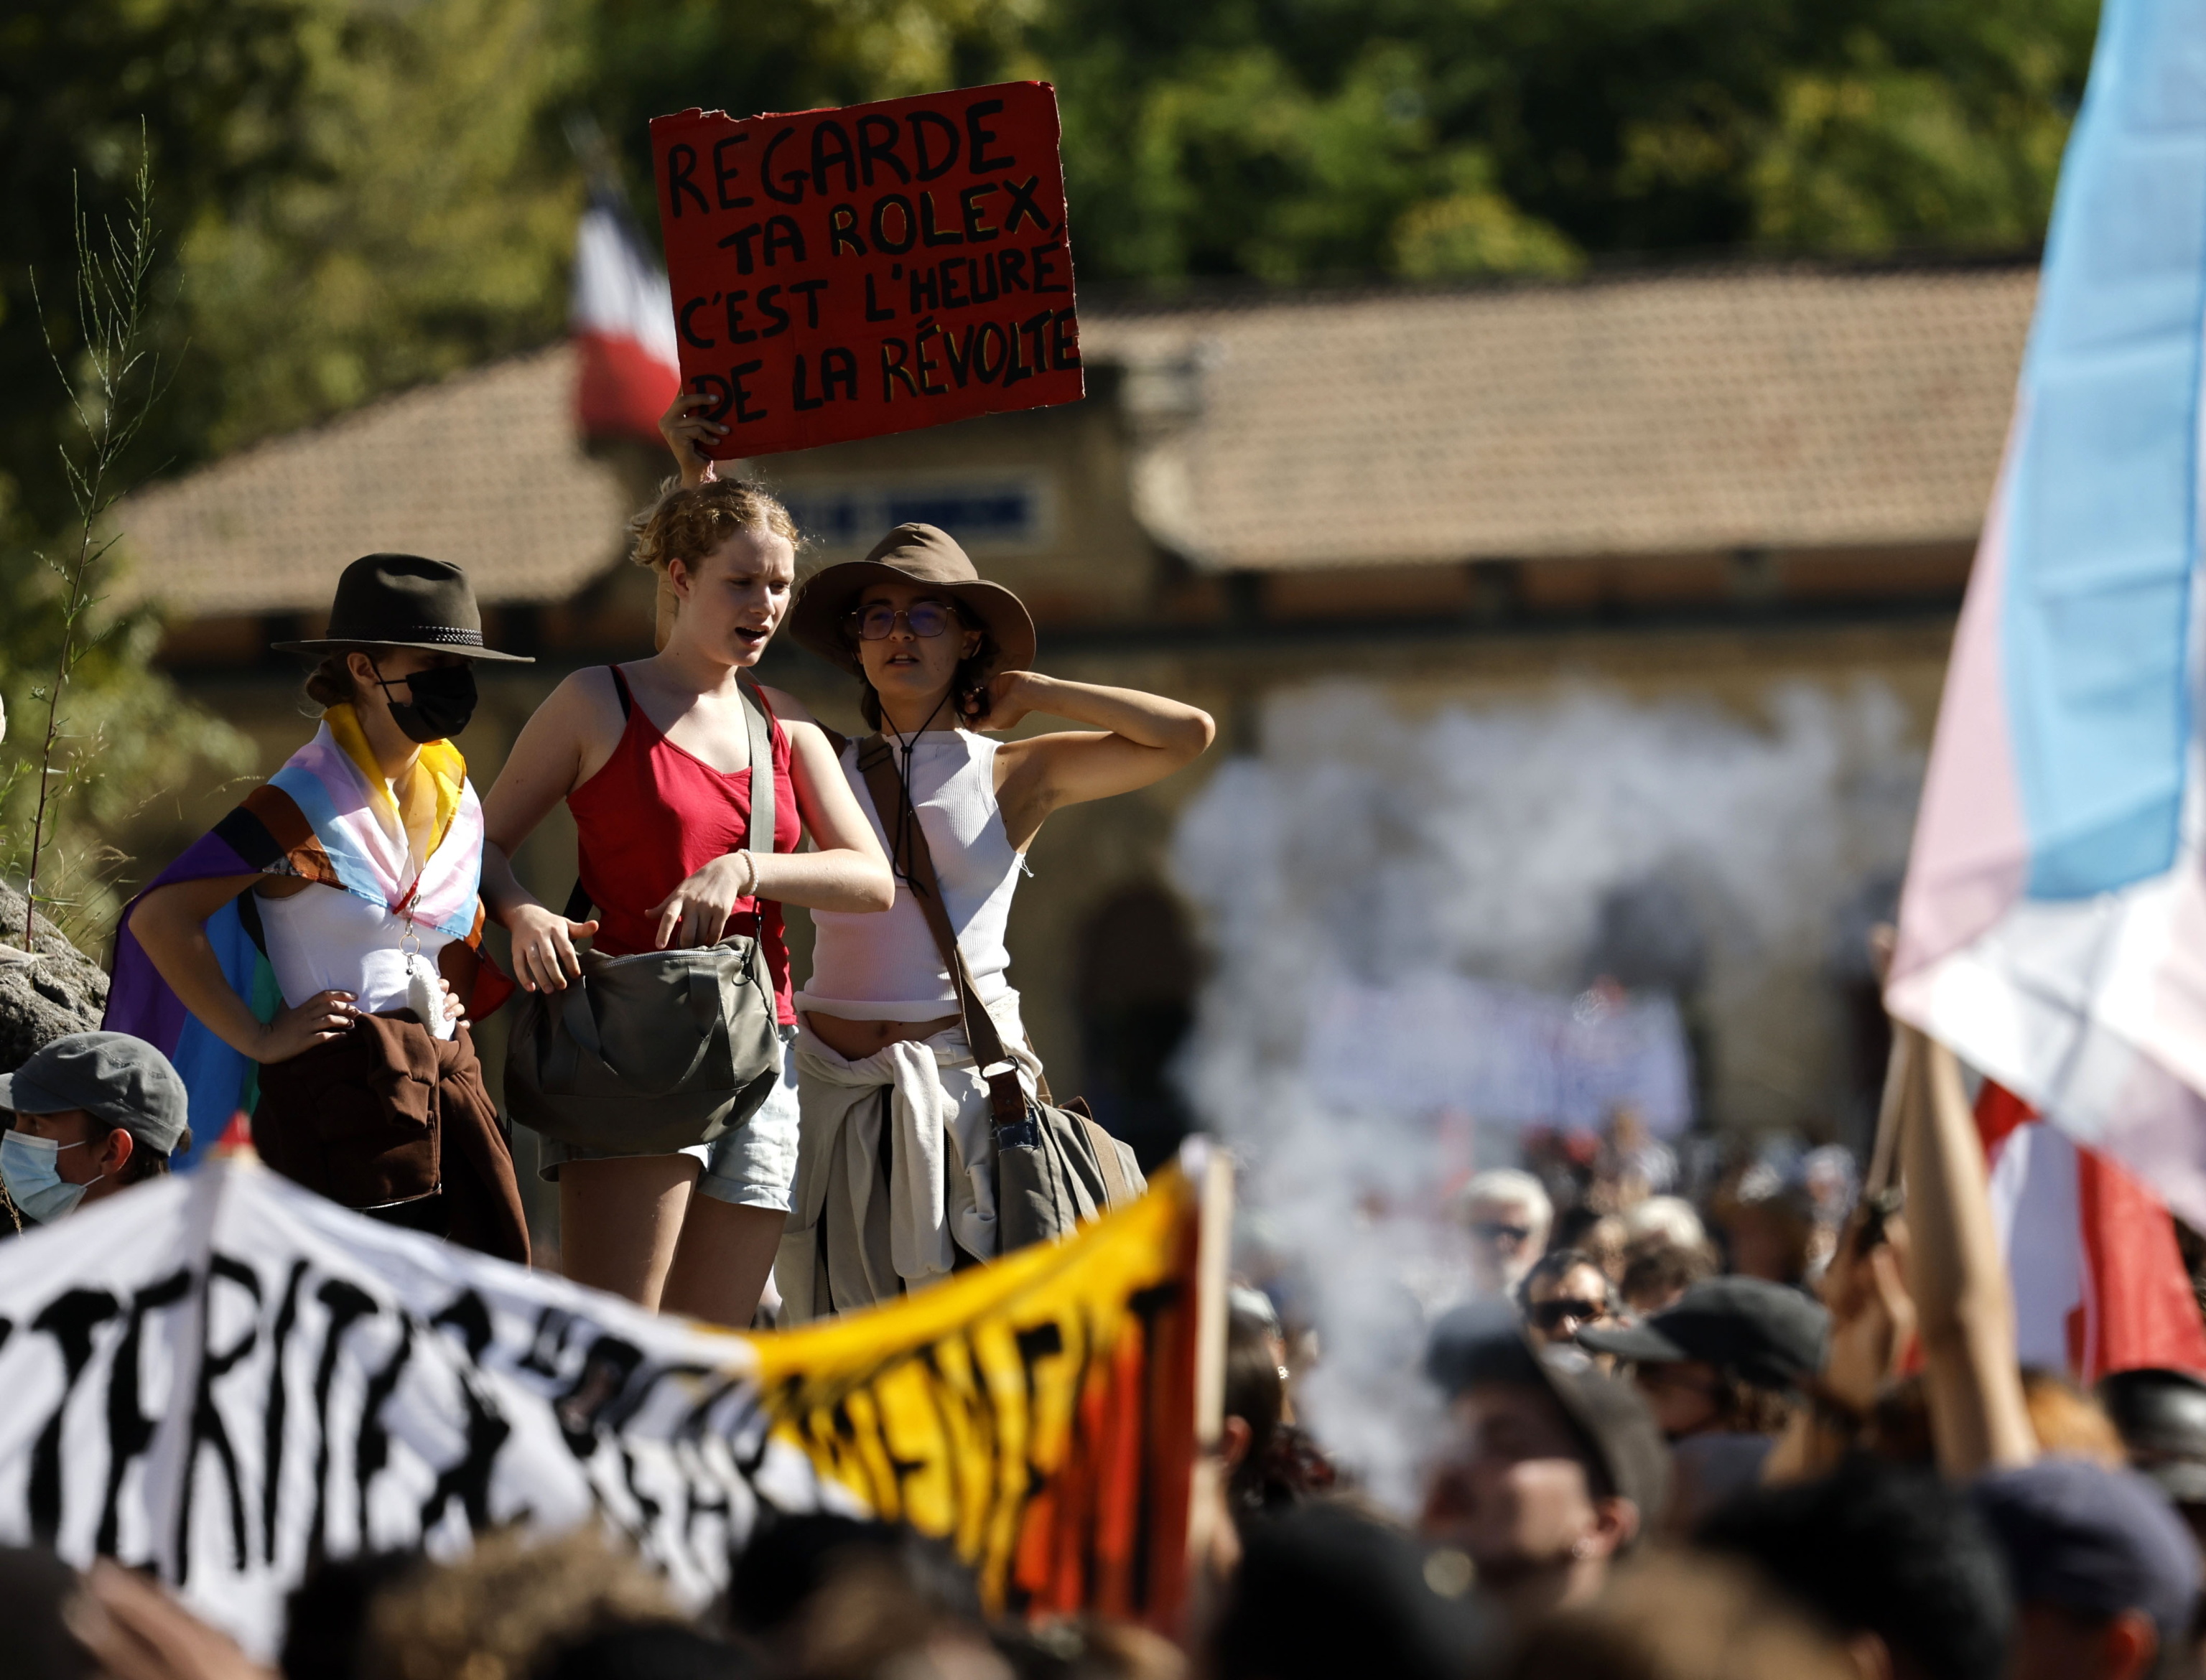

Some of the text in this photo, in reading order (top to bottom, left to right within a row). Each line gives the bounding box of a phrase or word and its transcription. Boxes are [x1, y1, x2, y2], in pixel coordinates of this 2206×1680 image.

[668, 99, 1016, 218] REGARDE
[718, 215, 806, 275] TA
[679, 279, 829, 349] C'EST
[690, 308, 1082, 425] DE LA RÉVOLTE
